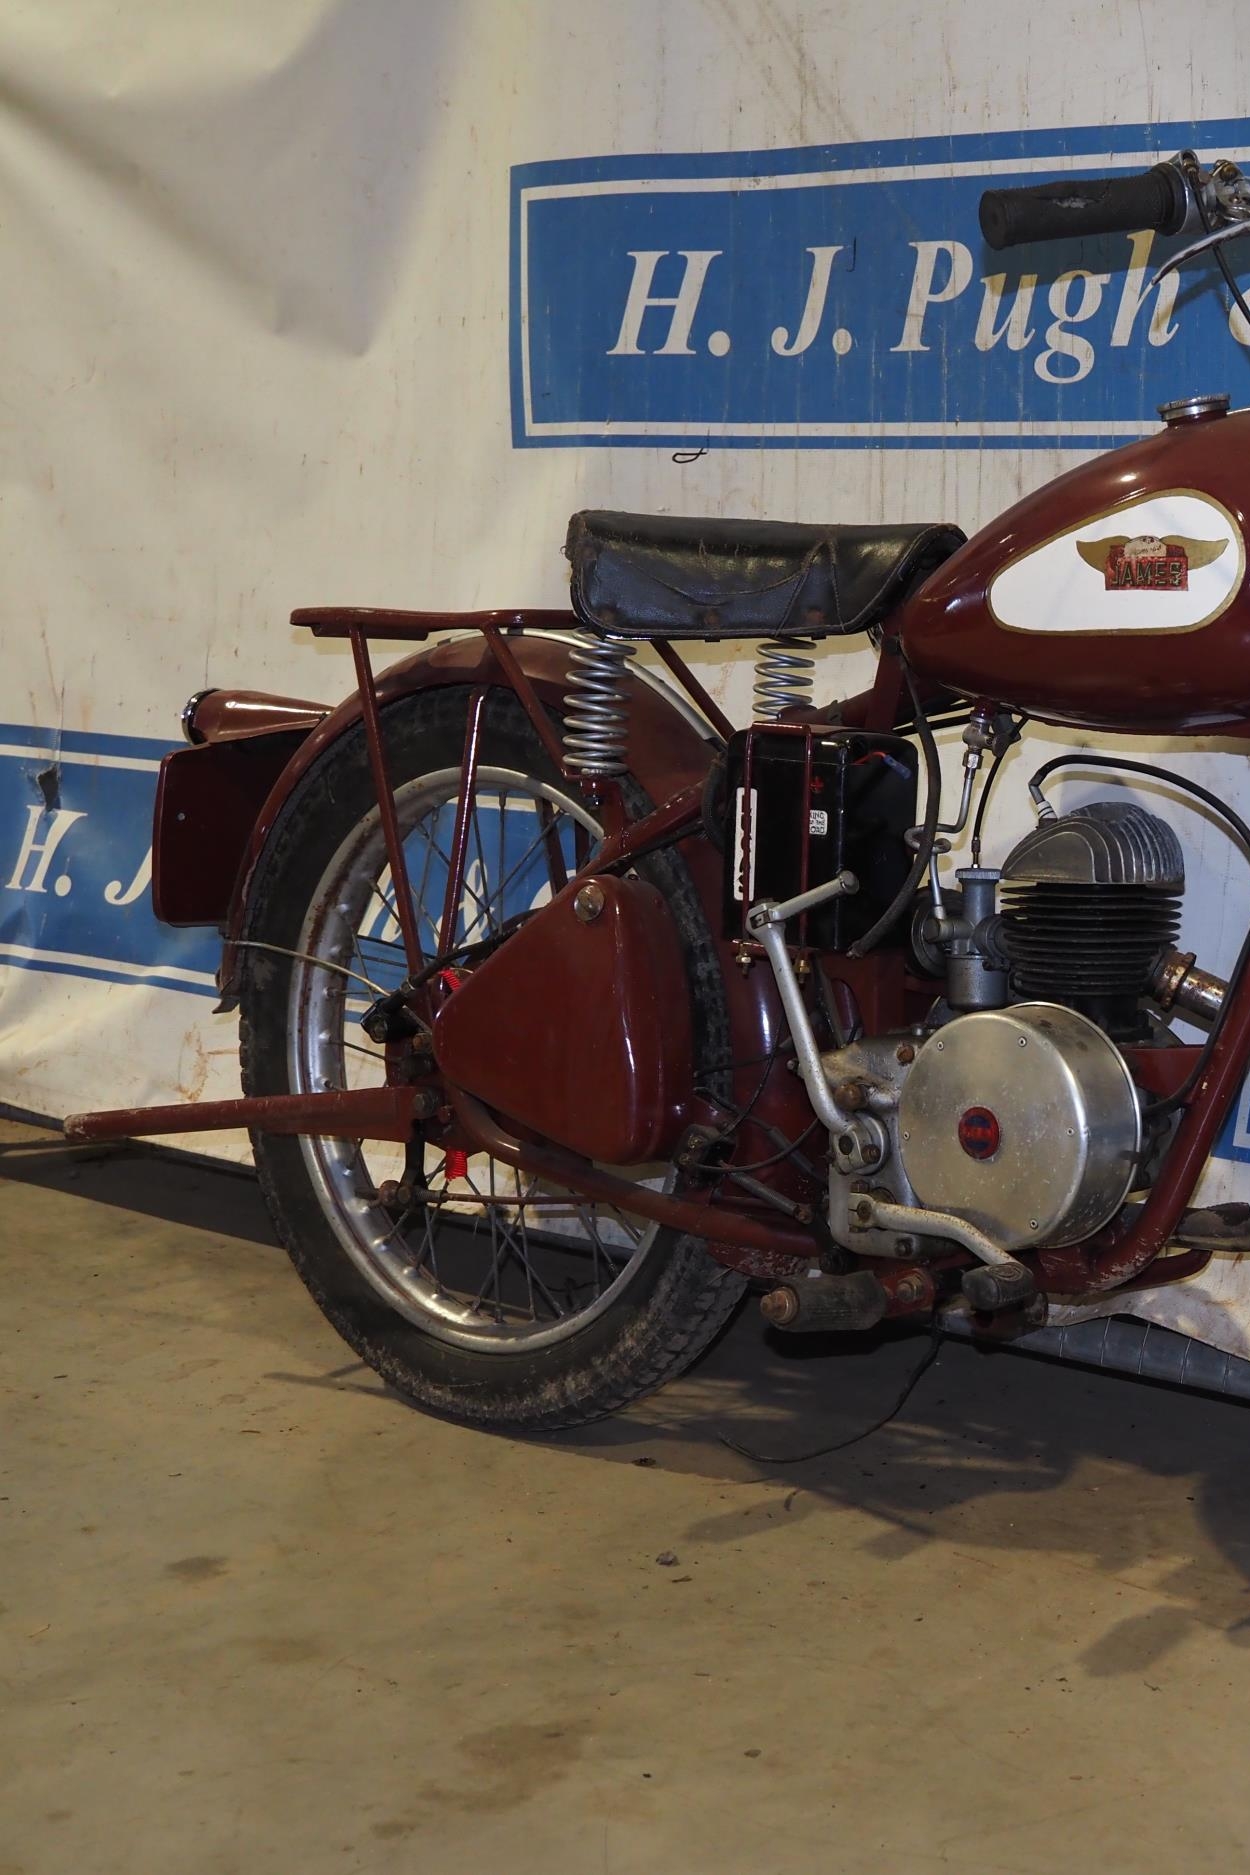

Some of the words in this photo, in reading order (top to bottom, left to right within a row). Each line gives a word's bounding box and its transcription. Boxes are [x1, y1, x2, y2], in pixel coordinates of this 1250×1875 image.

[606, 250, 730, 357] H.
[771, 245, 852, 356] J.
[889, 228, 1181, 384] Pugh
[1111, 561, 1182, 586] JAMES
[5, 804, 88, 897] H.
